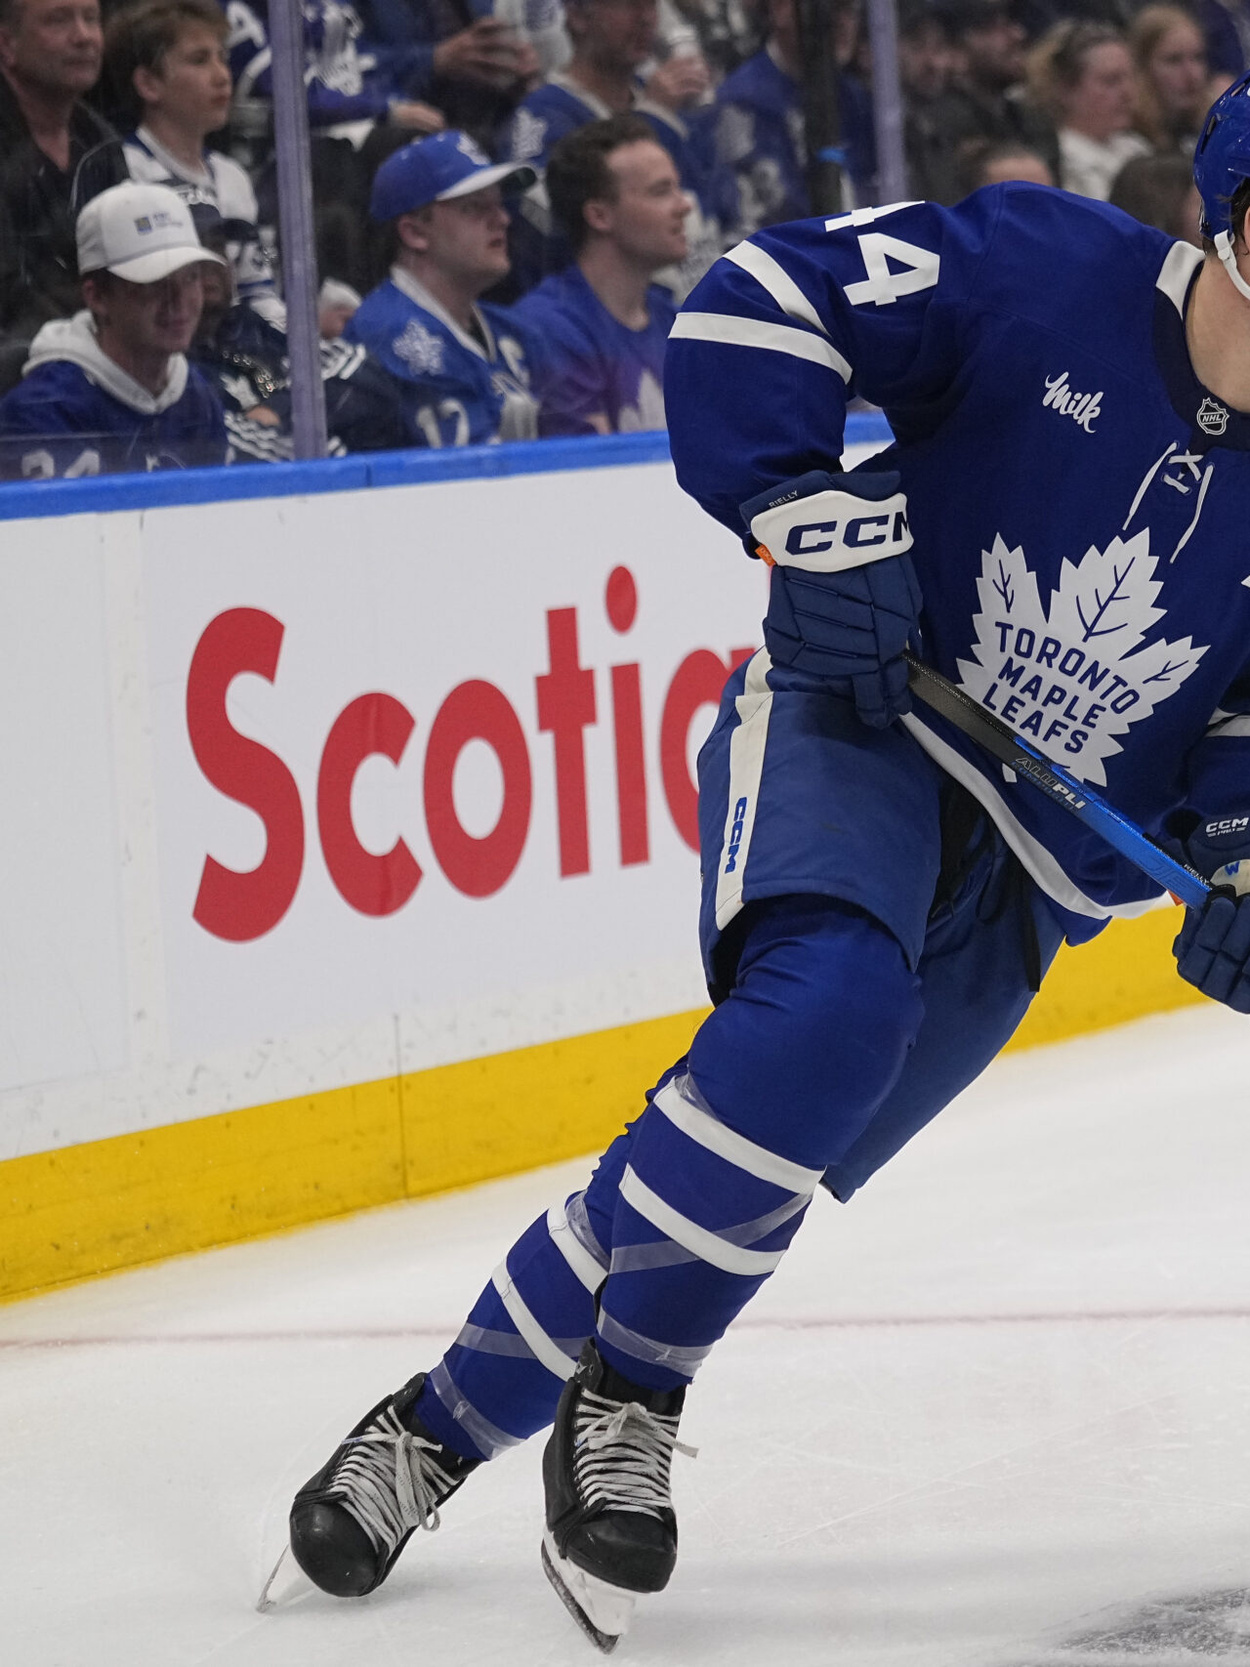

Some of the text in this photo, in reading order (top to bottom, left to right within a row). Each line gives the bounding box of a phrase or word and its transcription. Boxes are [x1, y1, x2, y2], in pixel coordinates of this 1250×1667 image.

[1042, 371, 1104, 434] Milk
[1202, 414, 1222, 422] NHL
[768, 490, 798, 508] RIELLY
[995, 621, 1140, 715] TORONTO
[998, 657, 1107, 729] MAPLE
[982, 682, 1089, 754] LEAFS
[724, 796, 747, 874] CCM
[1206, 817, 1249, 833] CCM
